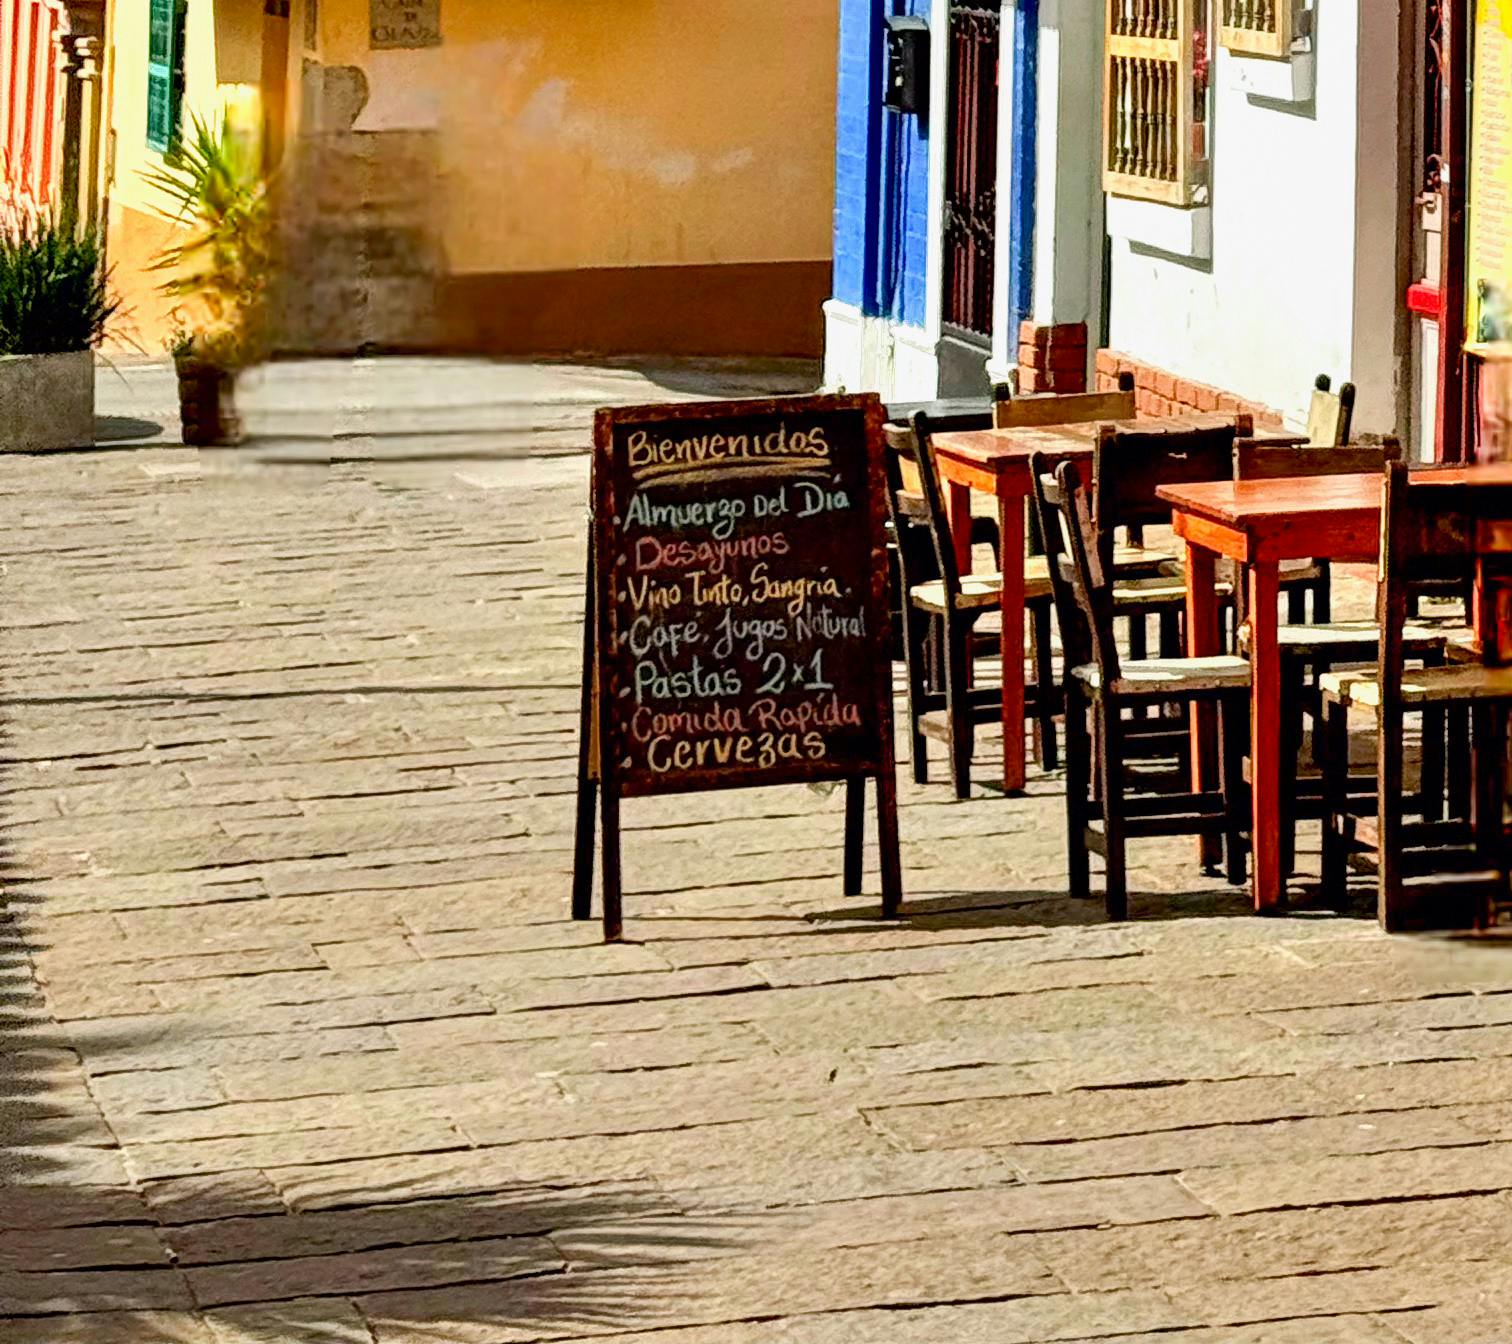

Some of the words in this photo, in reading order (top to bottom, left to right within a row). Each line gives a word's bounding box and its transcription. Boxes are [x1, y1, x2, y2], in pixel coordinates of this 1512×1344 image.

[628, 422, 830, 467] Bienvenidos
[622, 492, 746, 541] Almuerzo
[635, 532, 790, 574] Desayunos
[627, 575, 682, 611] Vino
[712, 607, 788, 661] Jugos
[634, 655, 742, 705] Pastas
[631, 700, 748, 742] Comida
[647, 731, 827, 773] Cervezas
